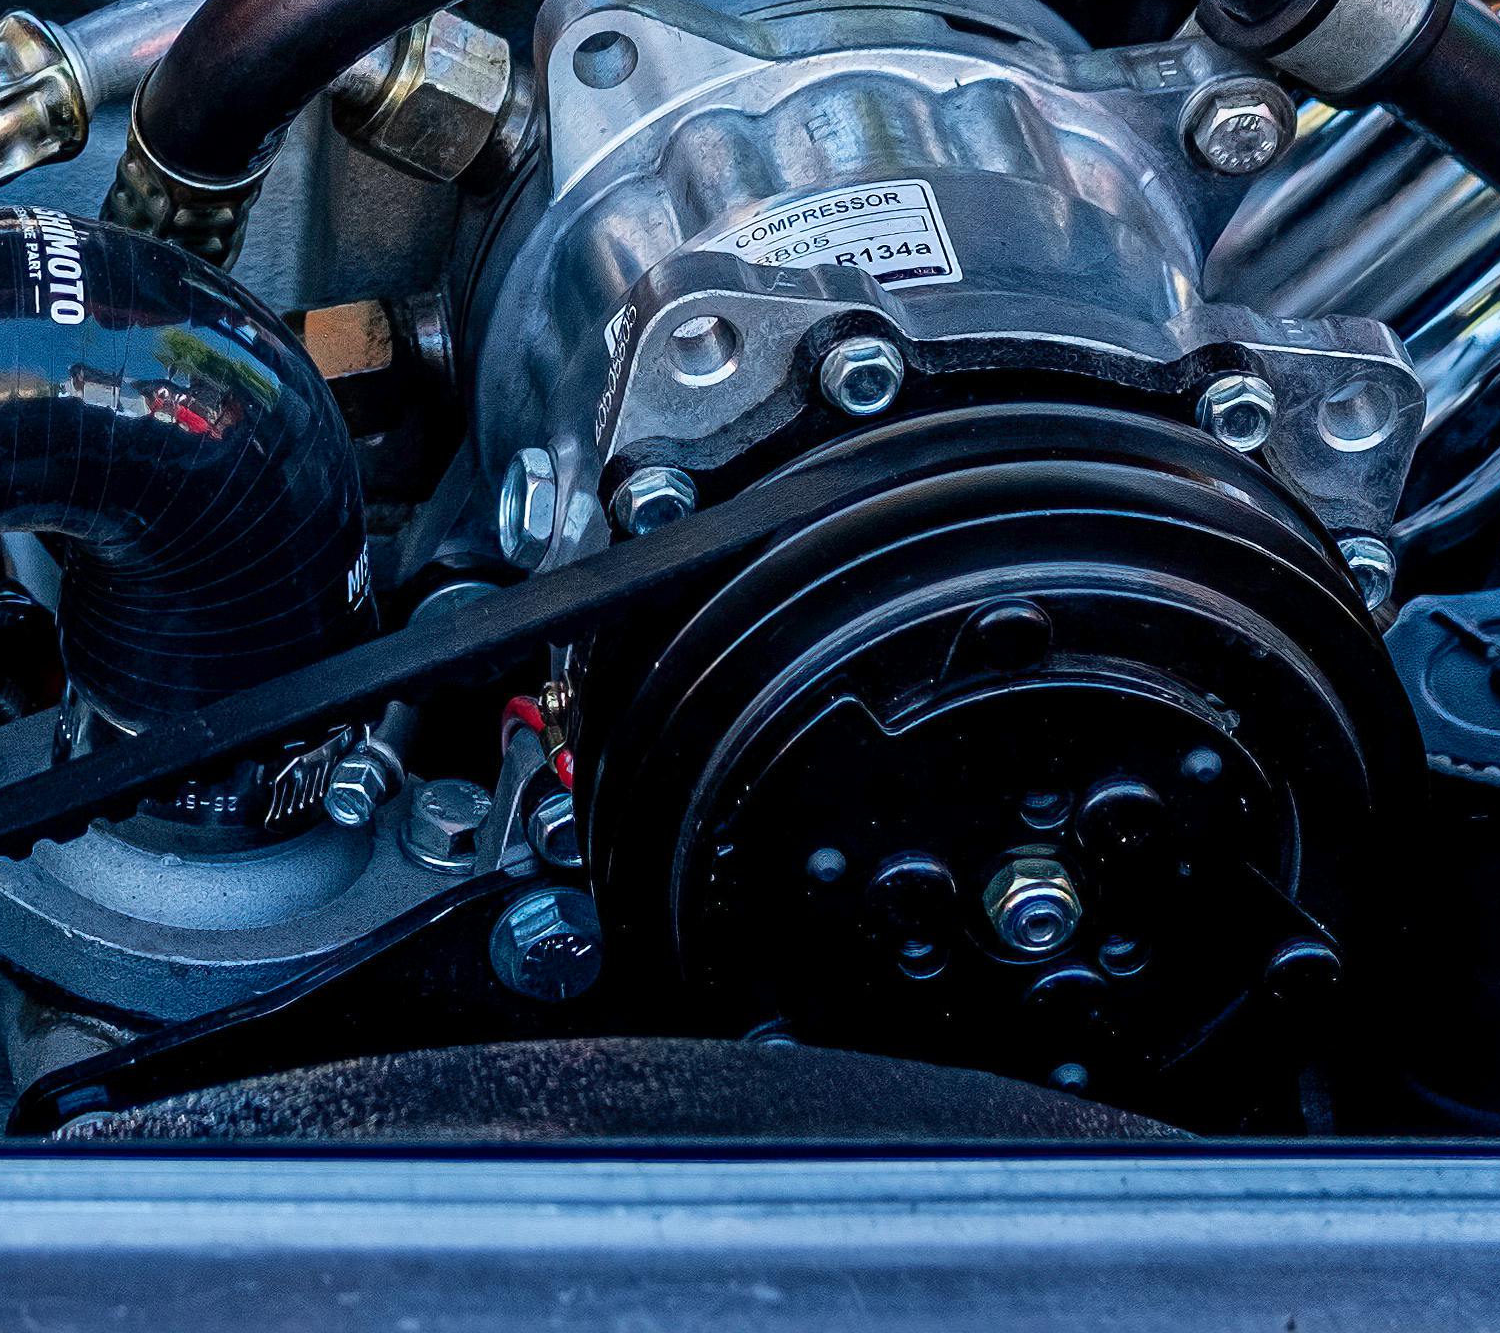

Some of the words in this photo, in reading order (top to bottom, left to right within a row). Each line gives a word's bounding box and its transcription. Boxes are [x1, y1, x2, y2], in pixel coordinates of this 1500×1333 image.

[735, 192, 901, 249] COMPRESSOR
[25, 243, 42, 281] PART
[835, 241, 932, 267] R134a
